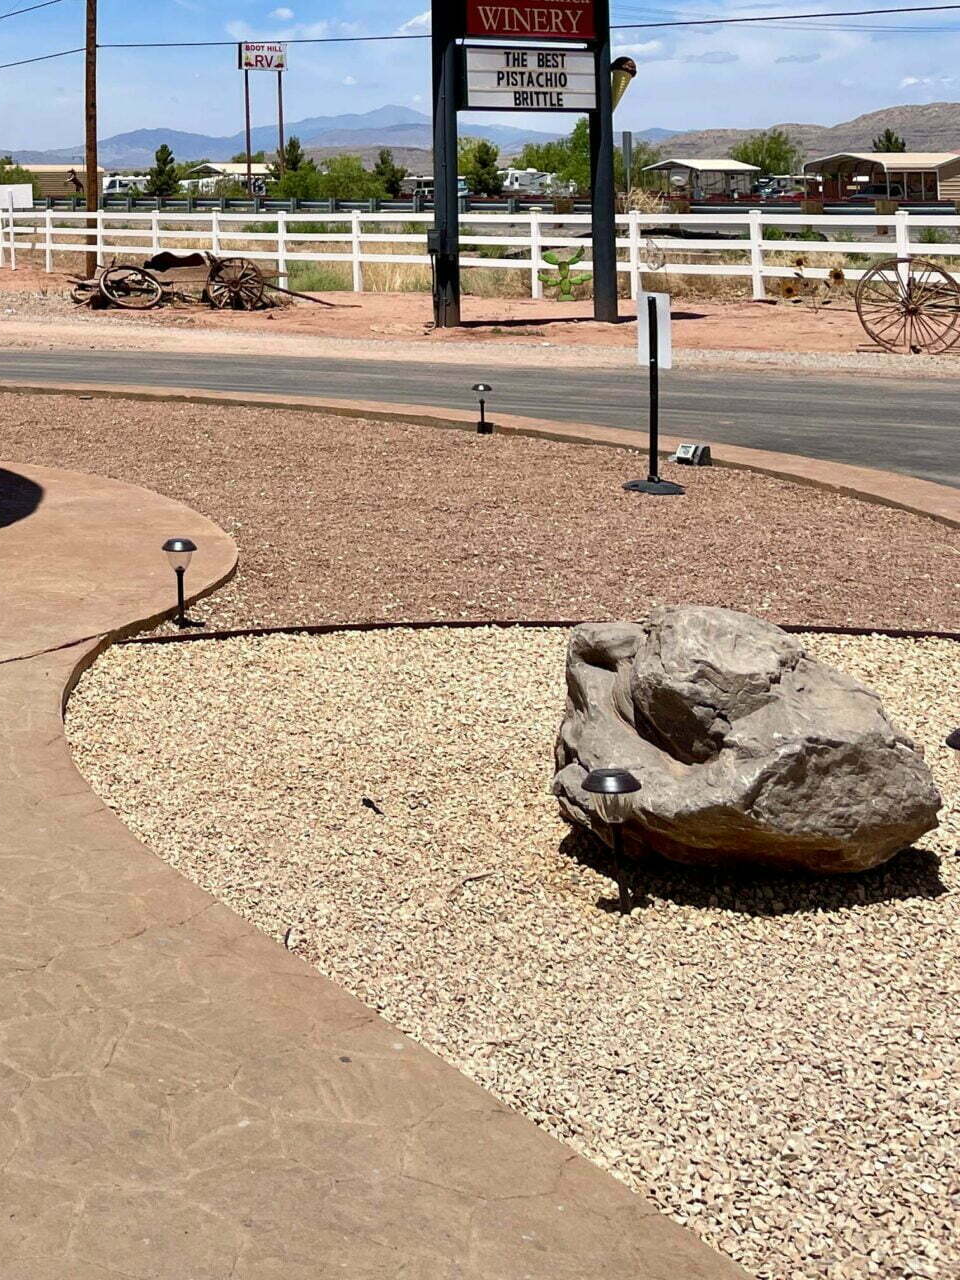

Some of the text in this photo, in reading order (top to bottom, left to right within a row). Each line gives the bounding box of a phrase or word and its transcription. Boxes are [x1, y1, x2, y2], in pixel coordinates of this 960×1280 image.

[477, 6, 583, 34] WINERY
[255, 54, 273, 68] RV
[504, 51, 566, 68] THE BEST
[497, 71, 568, 88] PISTACHIO
[514, 91, 564, 107] BRITTLE
